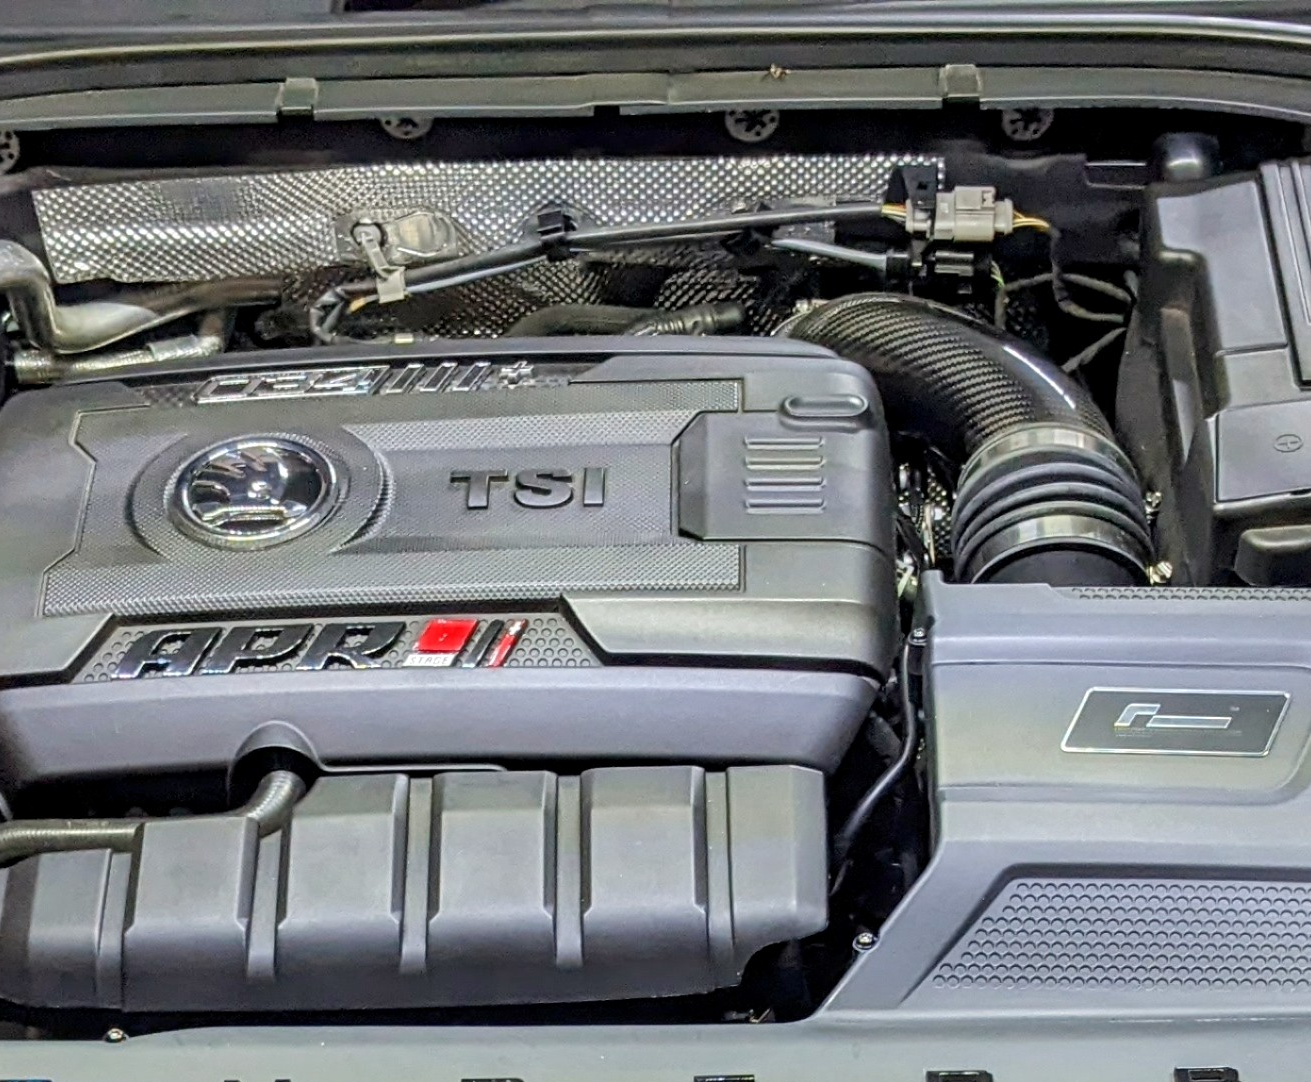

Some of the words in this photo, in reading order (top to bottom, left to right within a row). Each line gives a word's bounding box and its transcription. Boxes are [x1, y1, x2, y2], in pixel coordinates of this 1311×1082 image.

[450, 467, 606, 510] TSI
[111, 620, 407, 679] APR
[407, 655, 451, 665] STAGE
